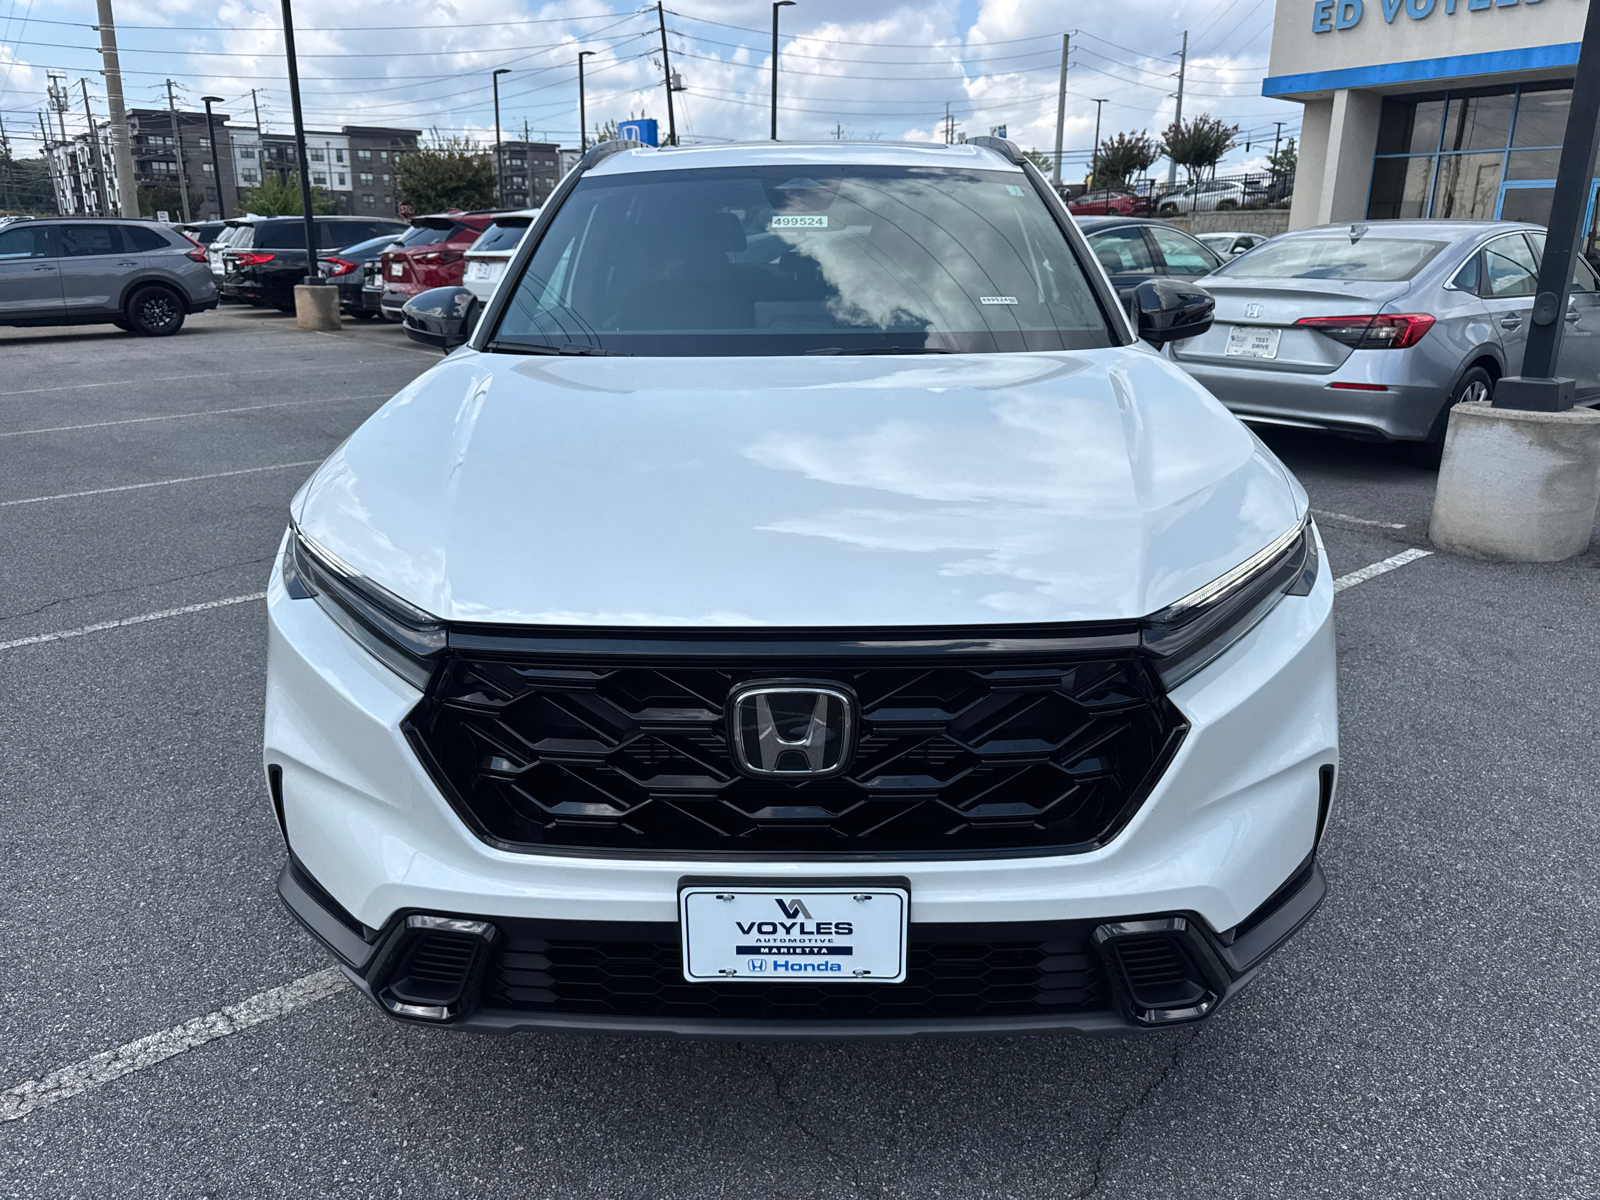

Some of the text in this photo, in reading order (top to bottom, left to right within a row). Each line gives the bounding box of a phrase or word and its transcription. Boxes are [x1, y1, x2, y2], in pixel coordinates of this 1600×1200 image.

[1312, 0, 1363, 33] ED
[774, 217, 823, 226] 499524
[735, 921, 853, 935] VOYLES
[773, 960, 842, 972] Honda
